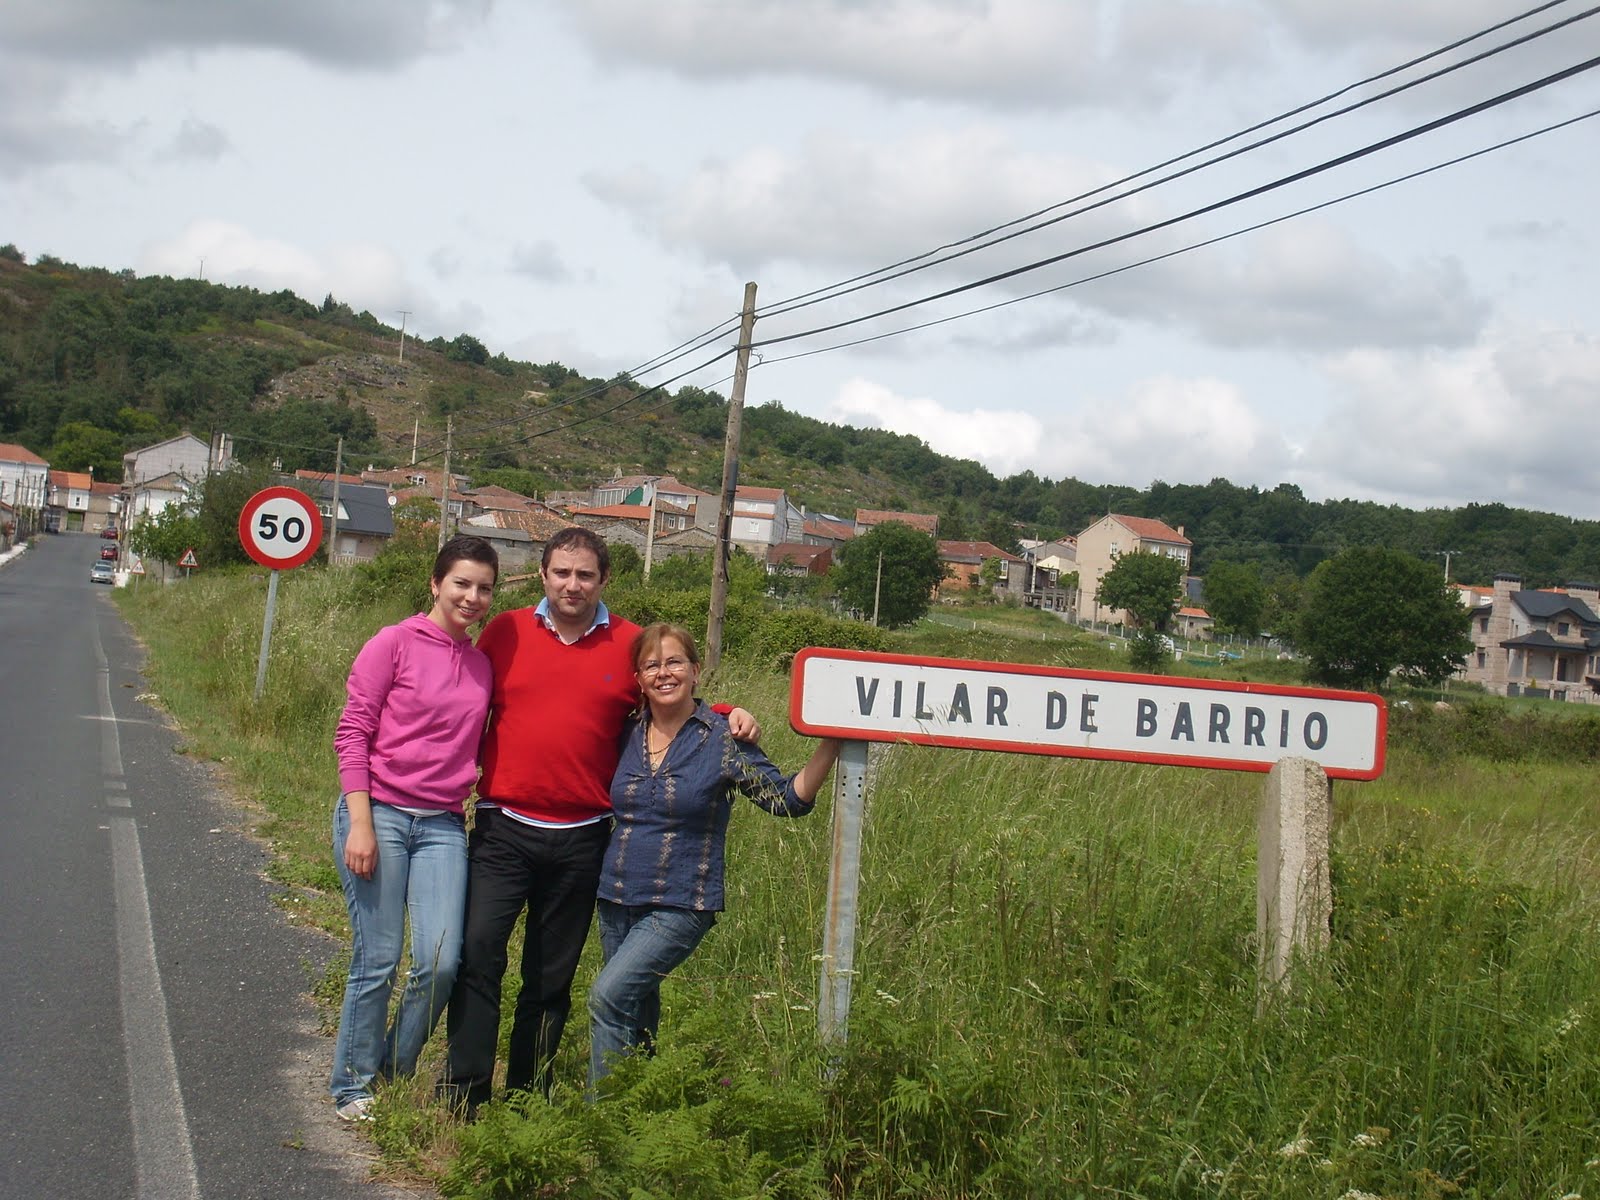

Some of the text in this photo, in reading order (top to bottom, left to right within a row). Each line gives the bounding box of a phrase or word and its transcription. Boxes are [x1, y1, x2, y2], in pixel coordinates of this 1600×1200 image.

[258, 513, 305, 543] 50
[855, 676, 1329, 751] VILAR DE BARRIO
